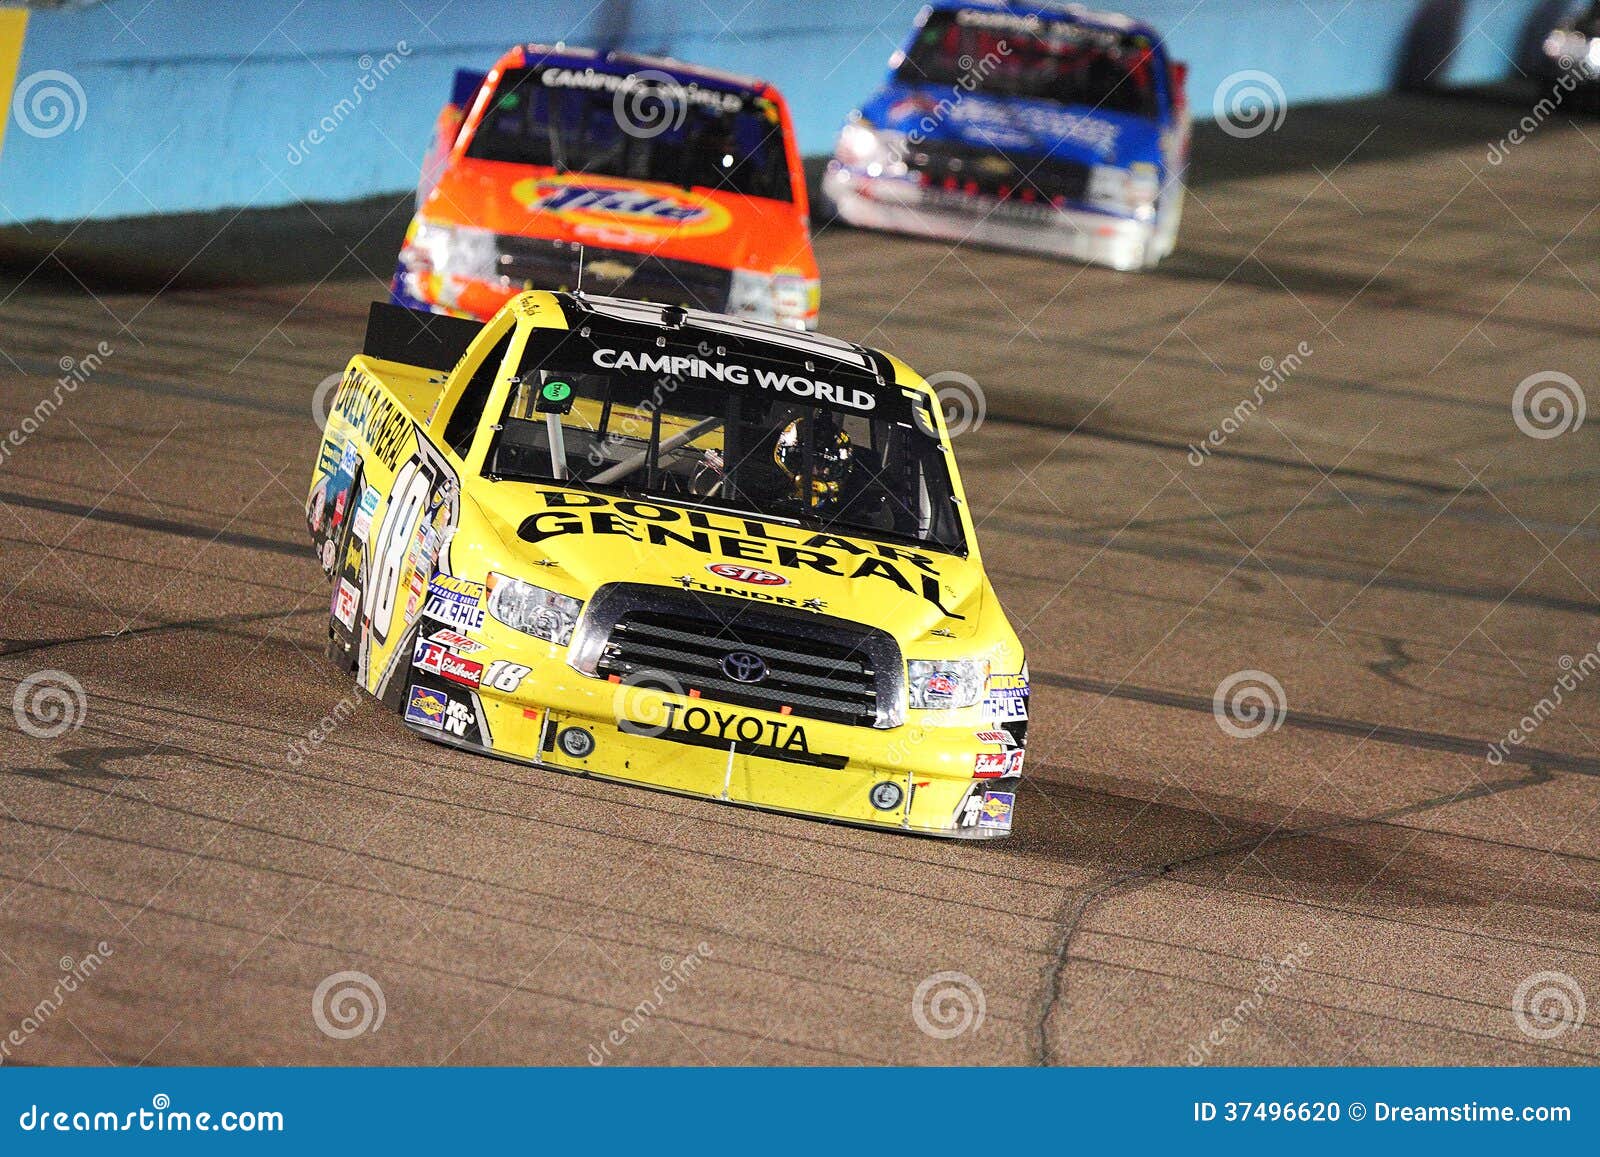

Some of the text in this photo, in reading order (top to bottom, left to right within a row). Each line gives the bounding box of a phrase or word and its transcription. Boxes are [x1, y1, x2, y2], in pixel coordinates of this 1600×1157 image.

[592, 348, 876, 411] CAMPING WORLD
[366, 397, 414, 473] GENERAL
[535, 490, 941, 576] DOLLAR
[430, 573, 484, 598] MOOG
[516, 511, 966, 621] GENERAL
[715, 566, 778, 584] STP
[677, 576, 826, 613] TUNDRA
[414, 642, 443, 667] JE
[480, 659, 534, 693] 18
[661, 701, 809, 753] TOYOTA
